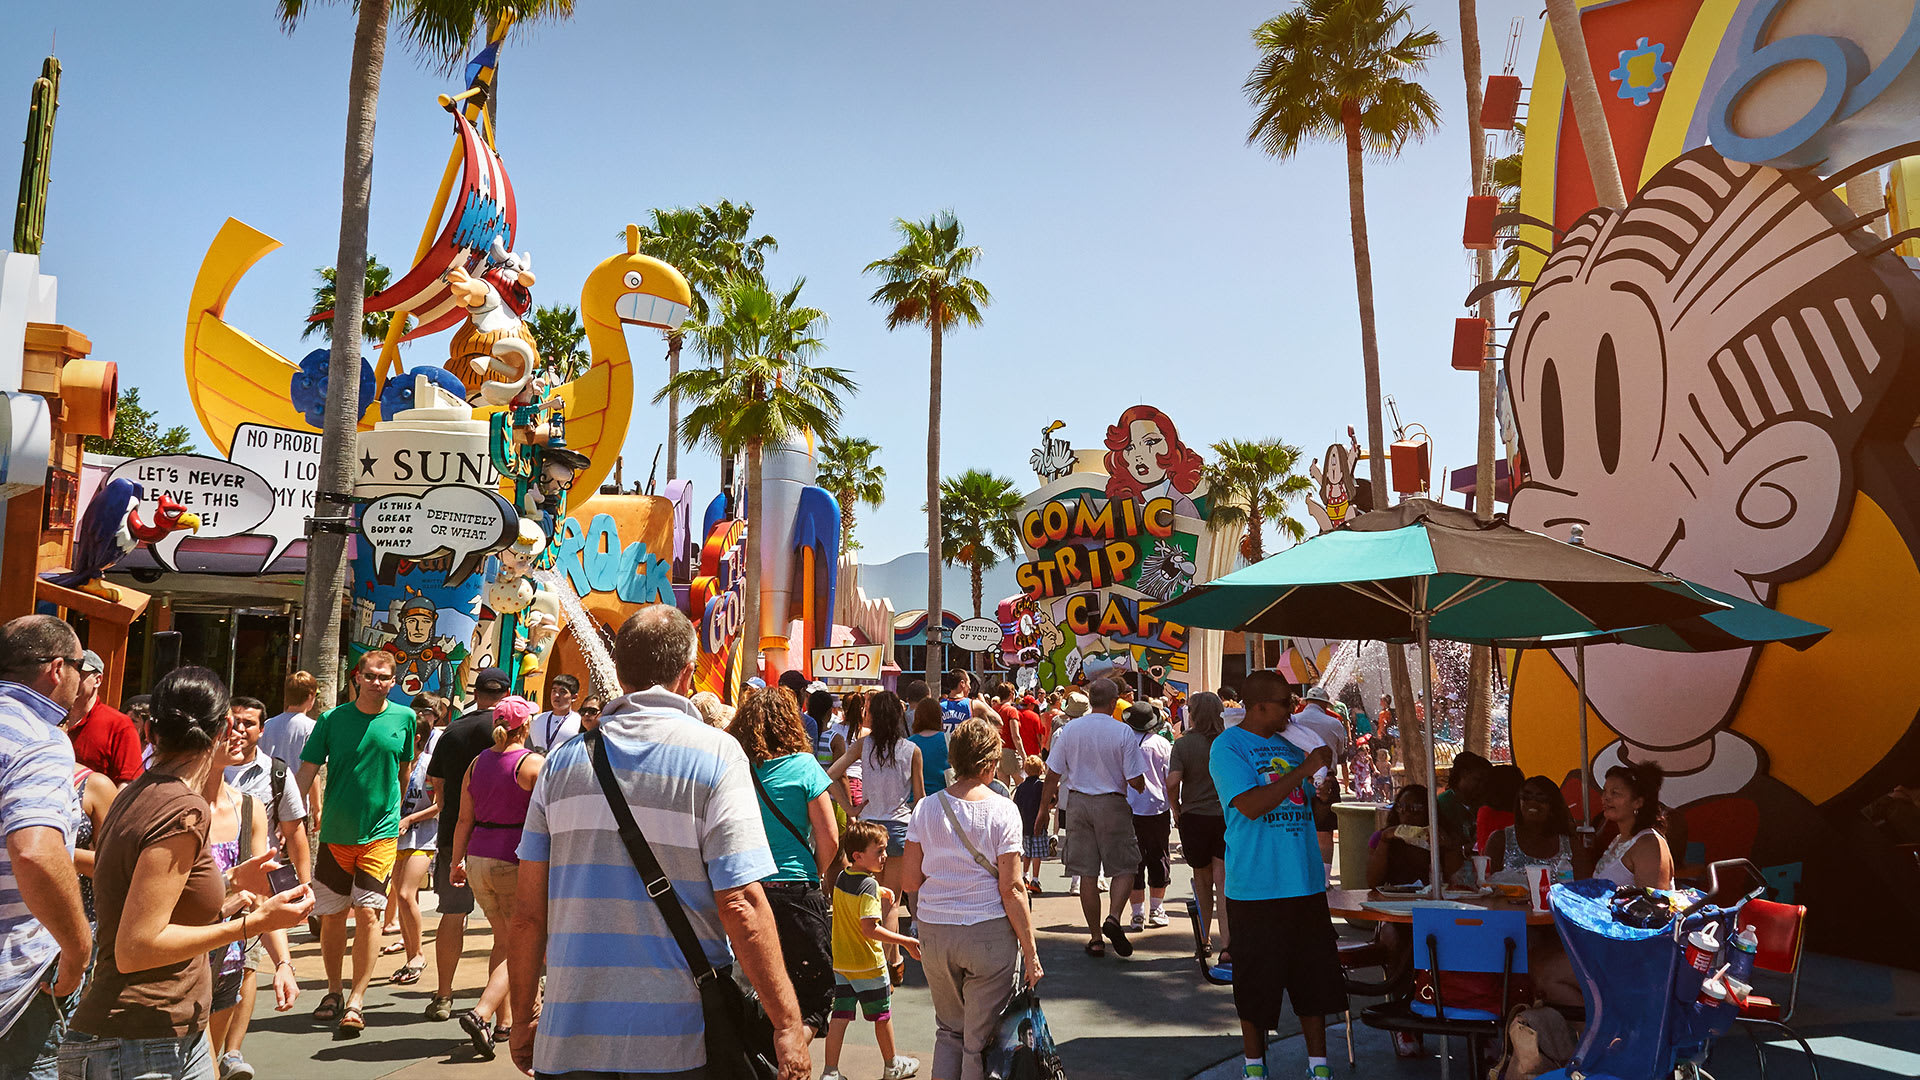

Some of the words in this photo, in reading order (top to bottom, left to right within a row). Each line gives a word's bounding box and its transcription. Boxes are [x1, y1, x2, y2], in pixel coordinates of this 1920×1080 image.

[246, 429, 268, 448] NO
[273, 432, 321, 455] PROBL
[138, 465, 178, 483] LET'S
[188, 470, 246, 489] NEVER
[284, 460, 288, 479] I
[297, 461, 321, 481] LO
[202, 492, 240, 508] THIS
[274, 487, 296, 507] MY
[302, 489, 314, 509] K
[379, 502, 388, 510] IS
[391, 502, 412, 510] THIS
[415, 502, 422, 510] A
[378, 514, 411, 522] GREAT
[427, 509, 497, 527] DEFINITELY
[1023, 496, 1174, 549] COMIC
[371, 526, 395, 534] BODY
[399, 526, 413, 534] OR
[431, 525, 447, 535] OR
[451, 527, 487, 541] WHAT.
[376, 539, 412, 548] WHAT?
[1016, 541, 1135, 600] STRIP
[961, 625, 999, 634] THINKING
[1066, 595, 1186, 650] CAFE
[822, 652, 870, 671] USED
